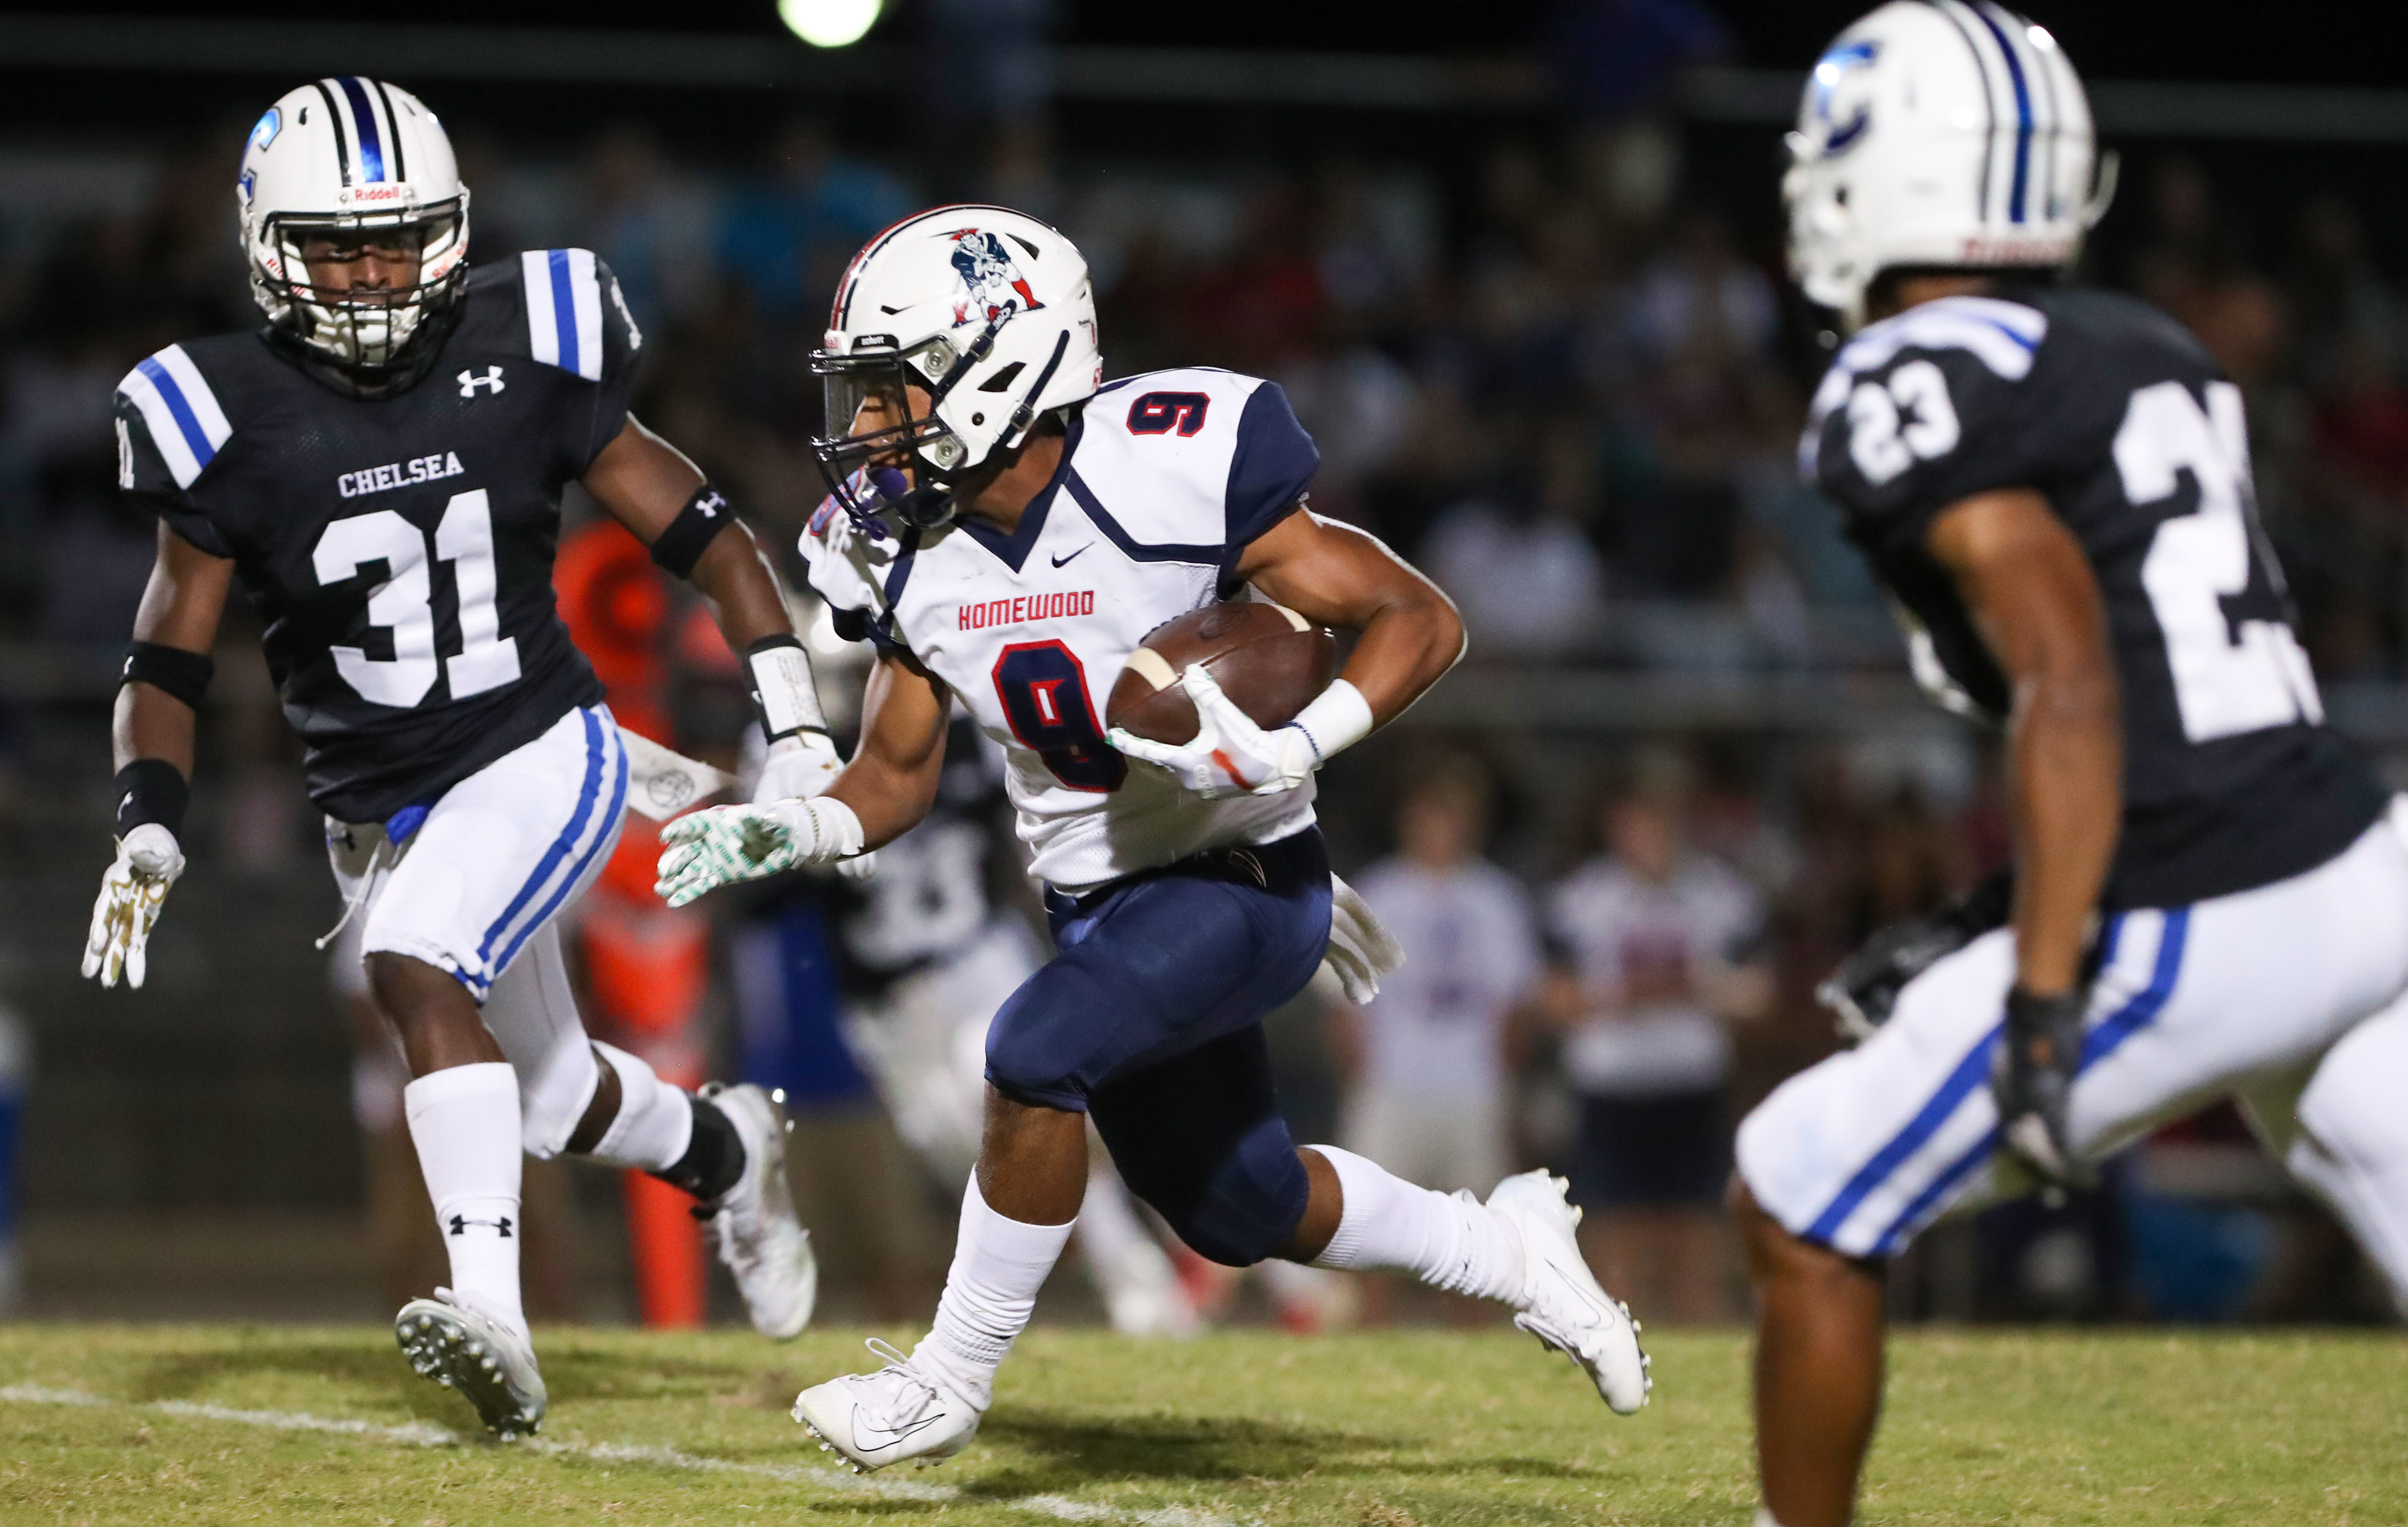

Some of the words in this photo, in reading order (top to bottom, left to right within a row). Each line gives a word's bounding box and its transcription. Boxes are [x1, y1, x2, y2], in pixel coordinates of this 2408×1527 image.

[356, 186, 400, 200] Riddell
[1126, 390, 1211, 438] 9
[1848, 360, 1960, 485] 23
[337, 451, 464, 498] CHELSEA
[311, 488, 522, 709] 31
[959, 590, 1094, 631] HOMEWOOD
